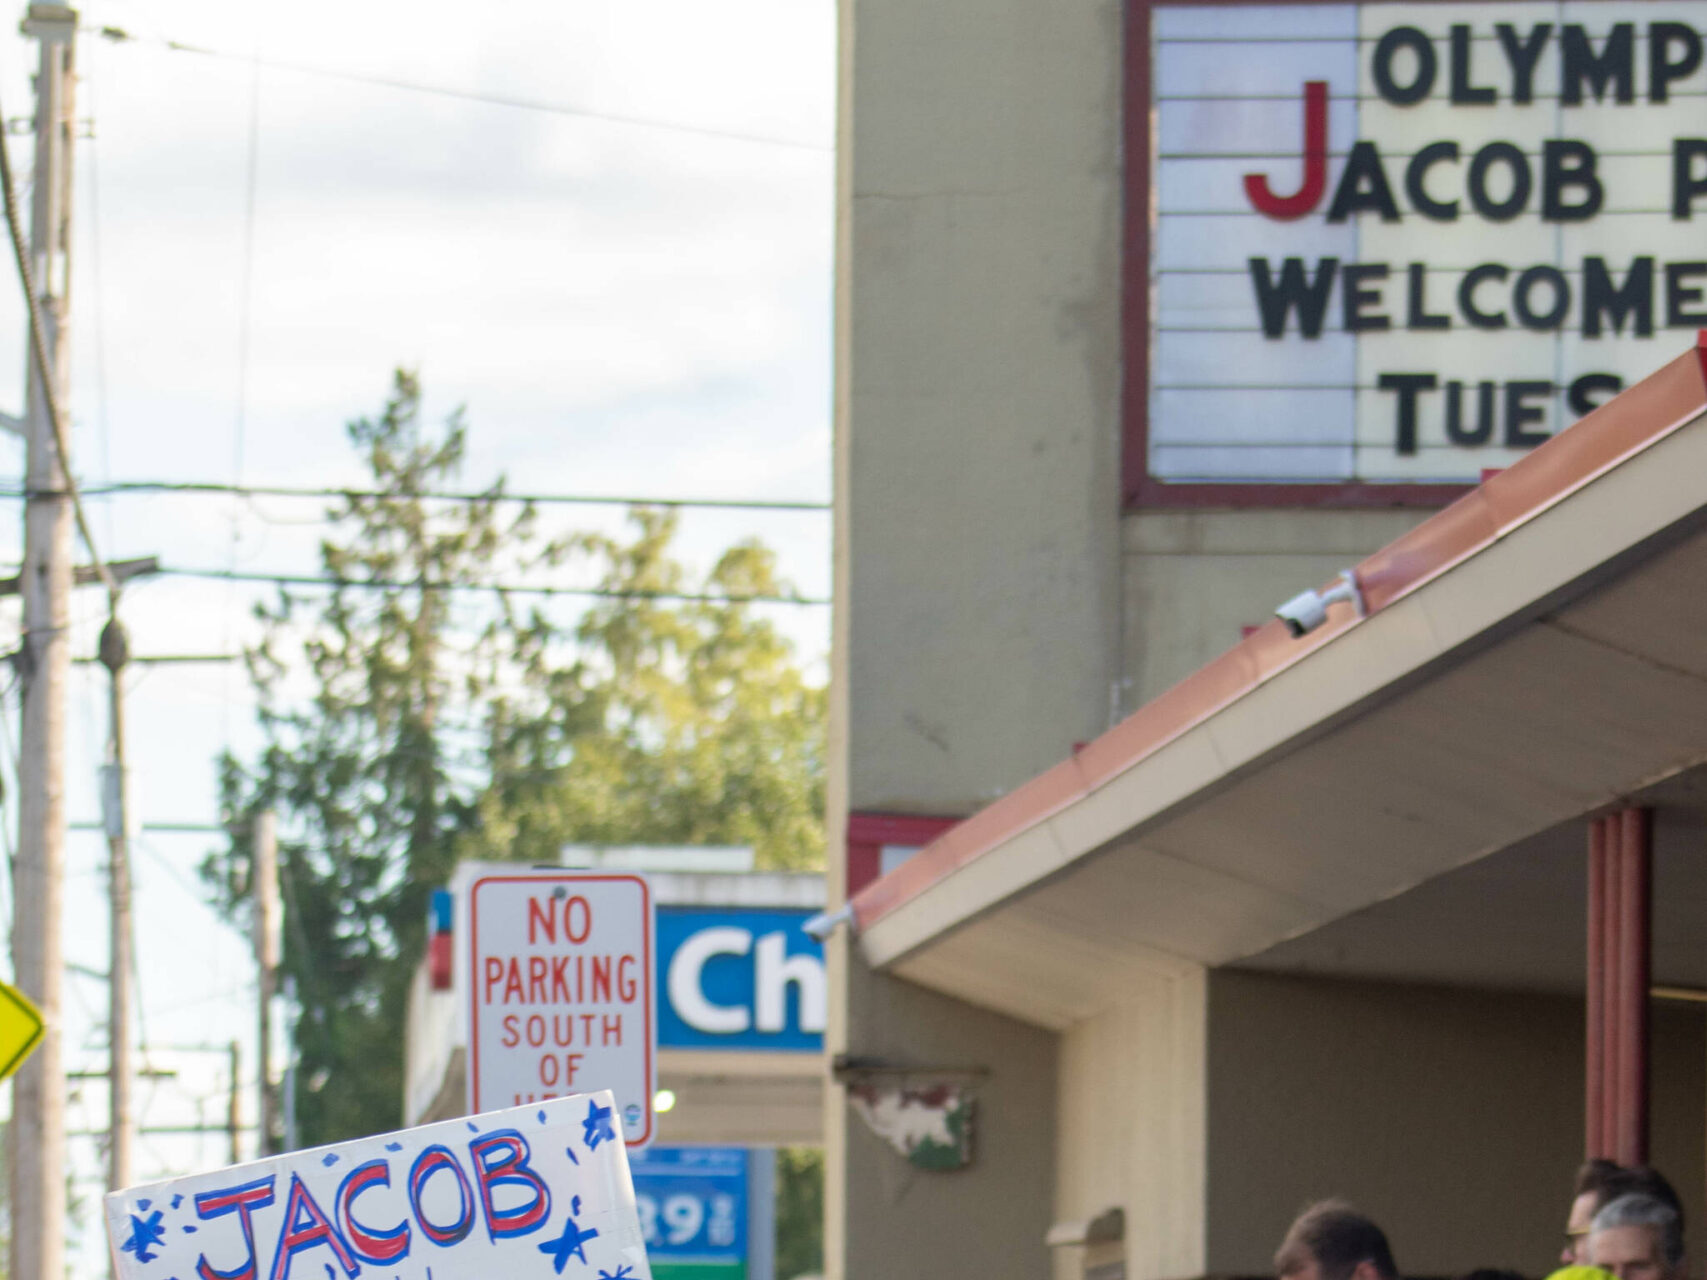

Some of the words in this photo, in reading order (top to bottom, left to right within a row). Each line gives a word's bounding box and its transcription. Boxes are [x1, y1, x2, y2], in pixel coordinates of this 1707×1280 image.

[1371, 21, 1704, 107] OLYMP
[1243, 81, 1604, 223] JACOB
[1248, 256, 1707, 340] WELCOME
[528, 895, 593, 945] NO
[484, 954, 638, 1004] PARKING
[667, 926, 826, 1034] Ch
[501, 1014, 623, 1048] SOUTH
[539, 1053, 584, 1087] OF
